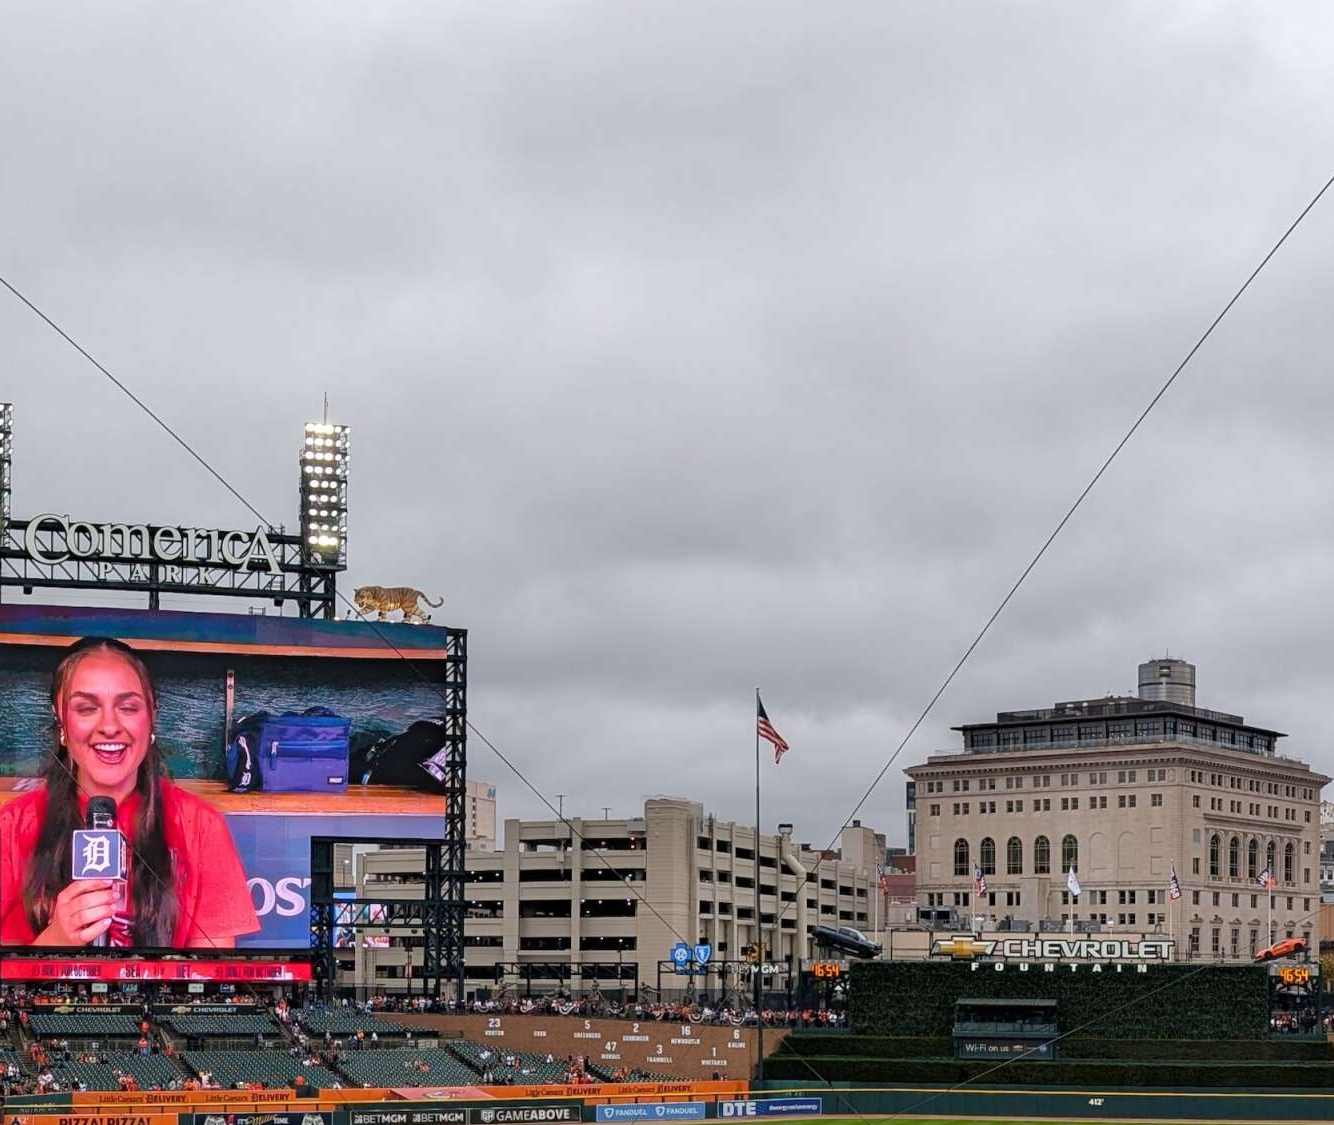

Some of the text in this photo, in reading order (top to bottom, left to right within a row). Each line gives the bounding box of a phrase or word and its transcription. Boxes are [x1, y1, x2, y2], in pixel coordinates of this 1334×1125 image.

[97, 563, 216, 585] PARK
[1003, 939, 1175, 959] CHEVROLET
[971, 963, 1148, 973] FOUNTAIN
[76, 1006, 122, 1015] CHEVROLET
[193, 1006, 238, 1015] CHEVROLET
[488, 1018, 501, 1028] 23
[584, 1020, 591, 1030] 5
[633, 1023, 639, 1033] 2
[681, 1026, 691, 1036] 16
[733, 1029, 740, 1039] 6
[605, 1042, 617, 1051] 47
[656, 1044, 663, 1054] 3
[965, 1043, 987, 1052] Wi-Fi
[712, 1047, 716, 1057] 1
[1087, 1098, 1105, 1106] 412'
[496, 1108, 571, 1121] GAMEABOVE
[615, 1108, 648, 1117] FANDUEL
[666, 1106, 699, 1116] FANDUEL
[723, 1102, 757, 1117] DTE
[273, 1117, 289, 1125] TIME
[363, 1113, 407, 1124] BETMGM
[421, 1112, 464, 1123] BETMGM
